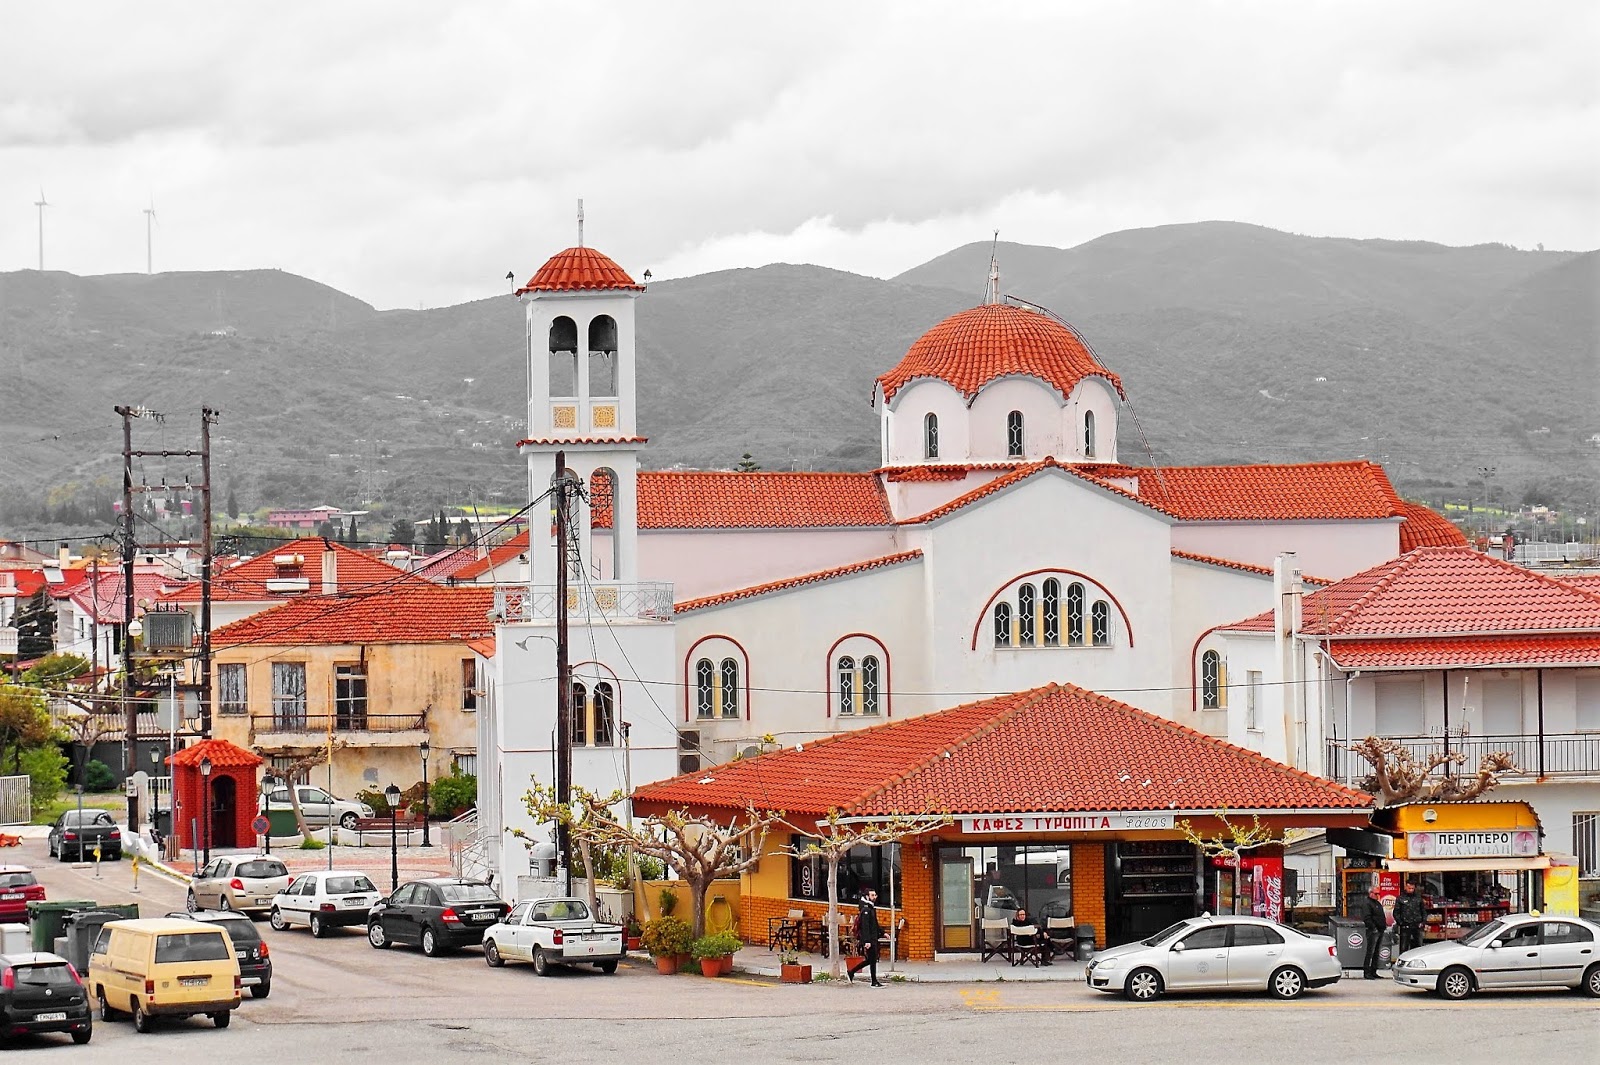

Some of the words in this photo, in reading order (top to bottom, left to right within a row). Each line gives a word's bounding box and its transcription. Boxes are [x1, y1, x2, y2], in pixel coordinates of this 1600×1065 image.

[973, 817, 1024, 831] ΚΑΦΕΣ
[1034, 816, 1111, 830] ΤΥΡΟΠΙΤΑ
[1439, 833, 1509, 845] ΠΕΡΙΠΤΕΡΟ
[1265, 875, 1281, 924] oca-Cola
